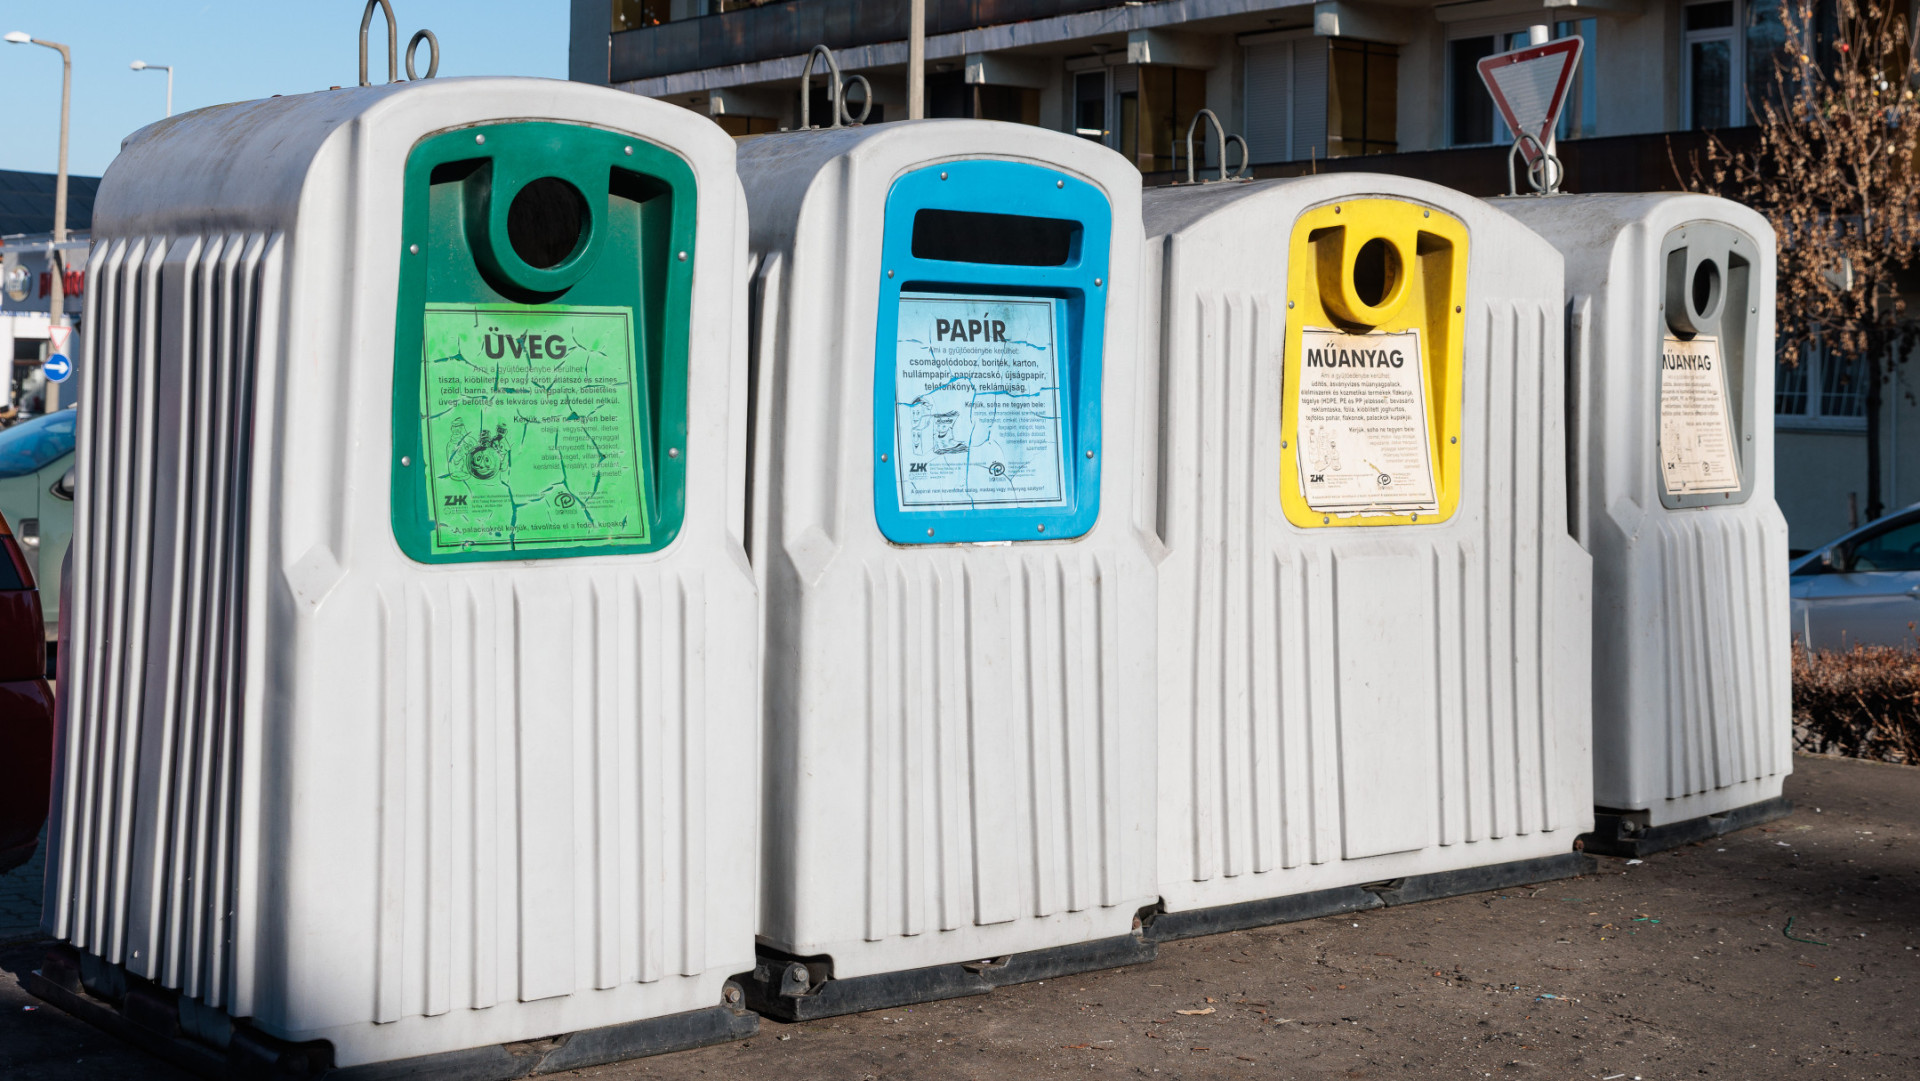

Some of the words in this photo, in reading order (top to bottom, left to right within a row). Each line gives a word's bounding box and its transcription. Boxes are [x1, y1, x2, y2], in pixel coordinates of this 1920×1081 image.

[936, 312, 1006, 343] PAPÍR
[484, 326, 567, 359] ÜVEG
[909, 358, 980, 369] csomagolódoboz,
[1012, 359, 1039, 368] karton,
[1307, 343, 1404, 368] MŰANYAG
[512, 377, 529, 386] vagy
[496, 397, 505, 406] és
[540, 398, 559, 408] üveg
